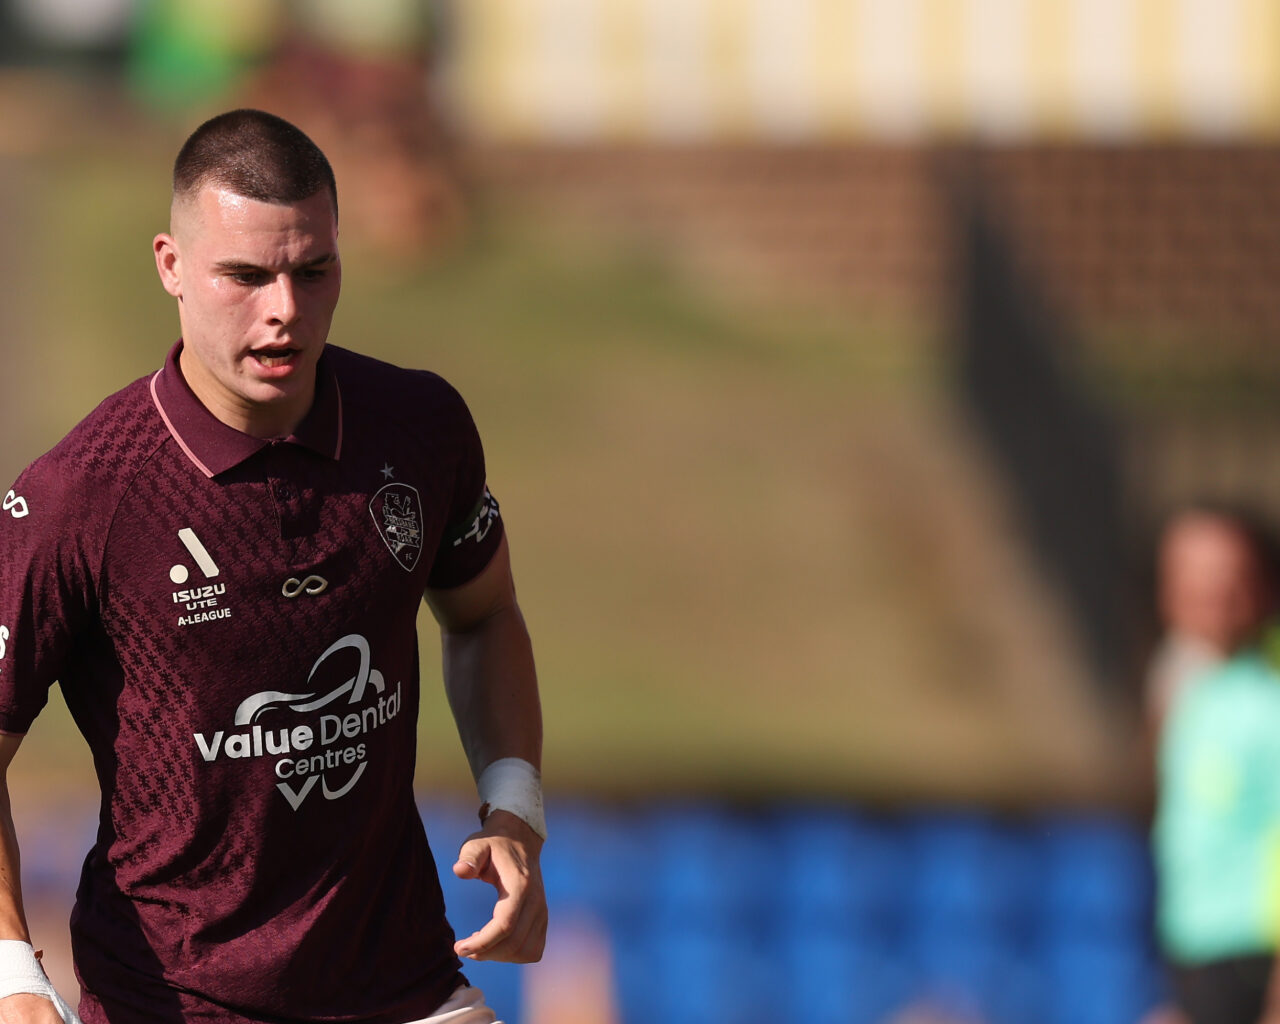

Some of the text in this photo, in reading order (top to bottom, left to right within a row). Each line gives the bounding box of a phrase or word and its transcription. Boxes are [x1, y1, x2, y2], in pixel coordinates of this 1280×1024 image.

[172, 583, 226, 603] ISUZU
[185, 598, 218, 611] UTE
[177, 607, 232, 627] A-LEAGUE
[193, 681, 401, 762] Value Dental
[274, 743, 367, 779] Centres
